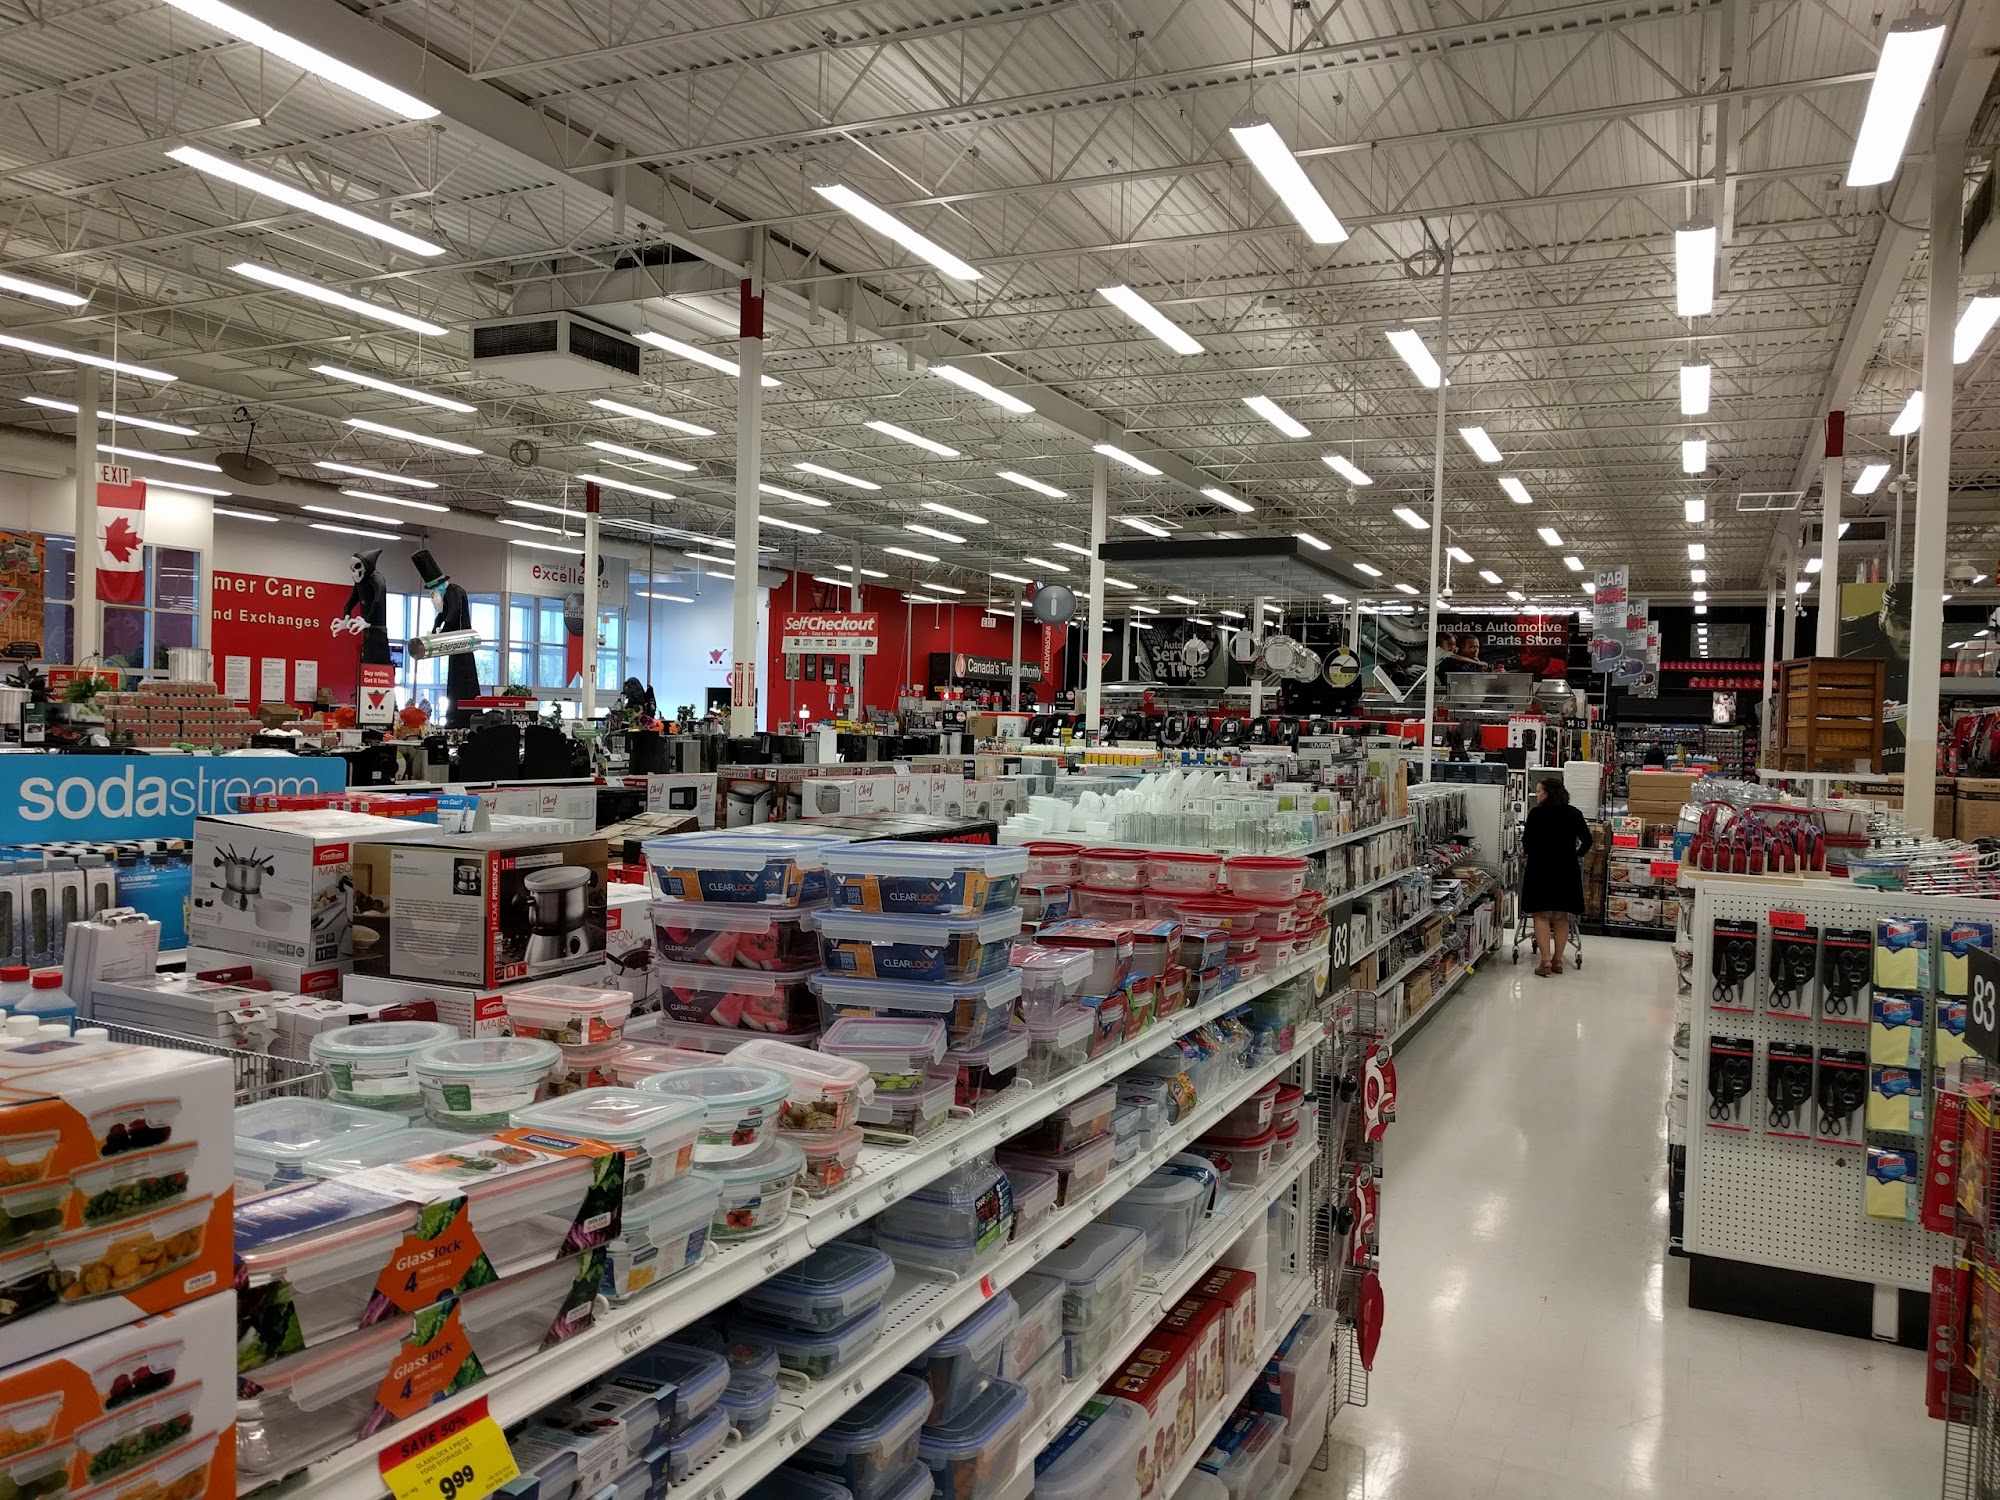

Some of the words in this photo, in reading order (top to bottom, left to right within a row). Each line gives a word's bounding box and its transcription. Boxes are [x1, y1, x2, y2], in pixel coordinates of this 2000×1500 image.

[103, 465, 129, 484] EXIT
[532, 565, 610, 589] excellece
[1598, 571, 1624, 587] CAR
[213, 576, 257, 593] mer
[264, 577, 316, 599] Care
[1594, 587, 1627, 604] CARE
[1594, 606, 1627, 616] STARTS
[213, 609, 232, 621] nd
[239, 609, 320, 630] Exchanges
[784, 616, 876, 631] SelfCheckout
[982, 618, 995, 627] EXIT
[1598, 616, 1621, 625] HERE
[1421, 621, 1483, 633] Cnada's
[1485, 622, 1563, 633] Automotive
[438, 640, 470, 652] Energizer
[1487, 634, 1522, 646] Parts
[1525, 634, 1563, 646] Store
[1043, 625, 1052, 674] INFORMATION
[967, 657, 1000, 676] Canada's
[1000, 661, 1014, 677] Tire
[1019, 664, 1042, 682] uthority
[1154, 661, 1168, 678] &
[1167, 661, 1207, 678] Tires
[828, 685, 835, 693] 8
[845, 686, 851, 694] 7
[900, 689, 907, 697] 6
[914, 690, 921, 698] 5
[944, 712, 954, 720] 15
[1566, 719, 1575, 727] 14
[717, 771, 750, 779] COMPTOIR
[17, 764, 320, 822] sodastream
[859, 783, 874, 797] Chef
[543, 794, 558, 806] Chef
[491, 859, 499, 900] PRESENCE
[708, 883, 754, 892] CLEARLOCK
[889, 892, 938, 902] CLEARLOCK
[1774, 929, 1799, 937] Cuisinart
[1951, 930, 1980, 942] Windex
[1333, 922, 1349, 969] 83
[840, 957, 855, 965] BPA
[882, 958, 934, 969] CLEARLOCK
[456, 970, 482, 978] PRESENCE
[1883, 1002, 1910, 1014] Windex
[1972, 974, 1996, 1032] 83
[1711, 1042, 1734, 1050] Cuisinart
[1882, 1071, 1908, 1083] Windex
[1877, 1157, 1904, 1168] Windex
[396, 1240, 461, 1271] Glasslock
[404, 1271, 418, 1293] 4
[393, 1342, 452, 1380] Glasslock
[400, 1379, 413, 1399] 4
[401, 1429, 438, 1459] SAVE
[440, 1416, 468, 1438] 50%
[415, 1446, 449, 1470] GLASSLOCK
[452, 1436, 470, 1449] PIECE
[420, 1462, 437, 1476] FOOD
[436, 1450, 464, 1468] STORAGE
[463, 1442, 474, 1454] SET
